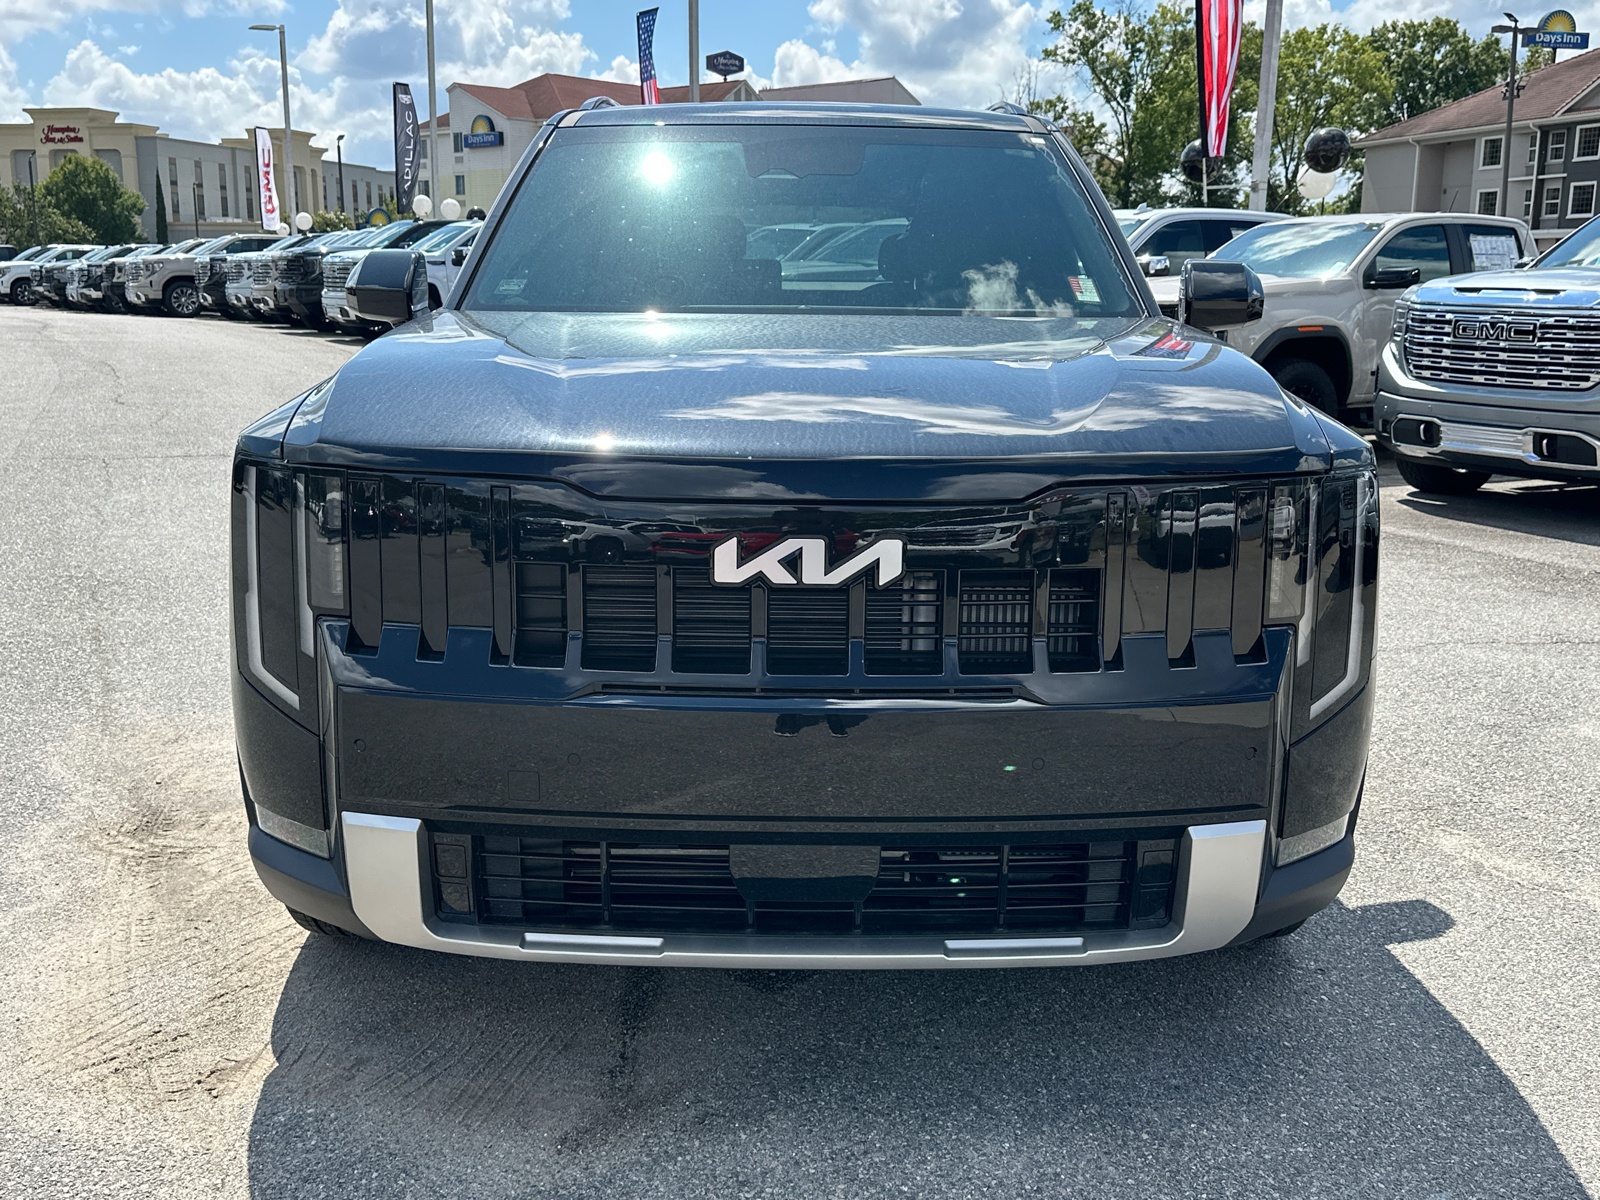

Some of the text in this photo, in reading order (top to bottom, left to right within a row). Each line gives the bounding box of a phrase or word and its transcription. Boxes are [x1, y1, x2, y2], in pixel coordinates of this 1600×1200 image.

[1535, 32, 1581, 44] Days Inn
[468, 134, 495, 144] Days Inn
[402, 110, 414, 205] ADILLAC
[262, 148, 275, 214] GMC
[1455, 321, 1534, 341] GMC
